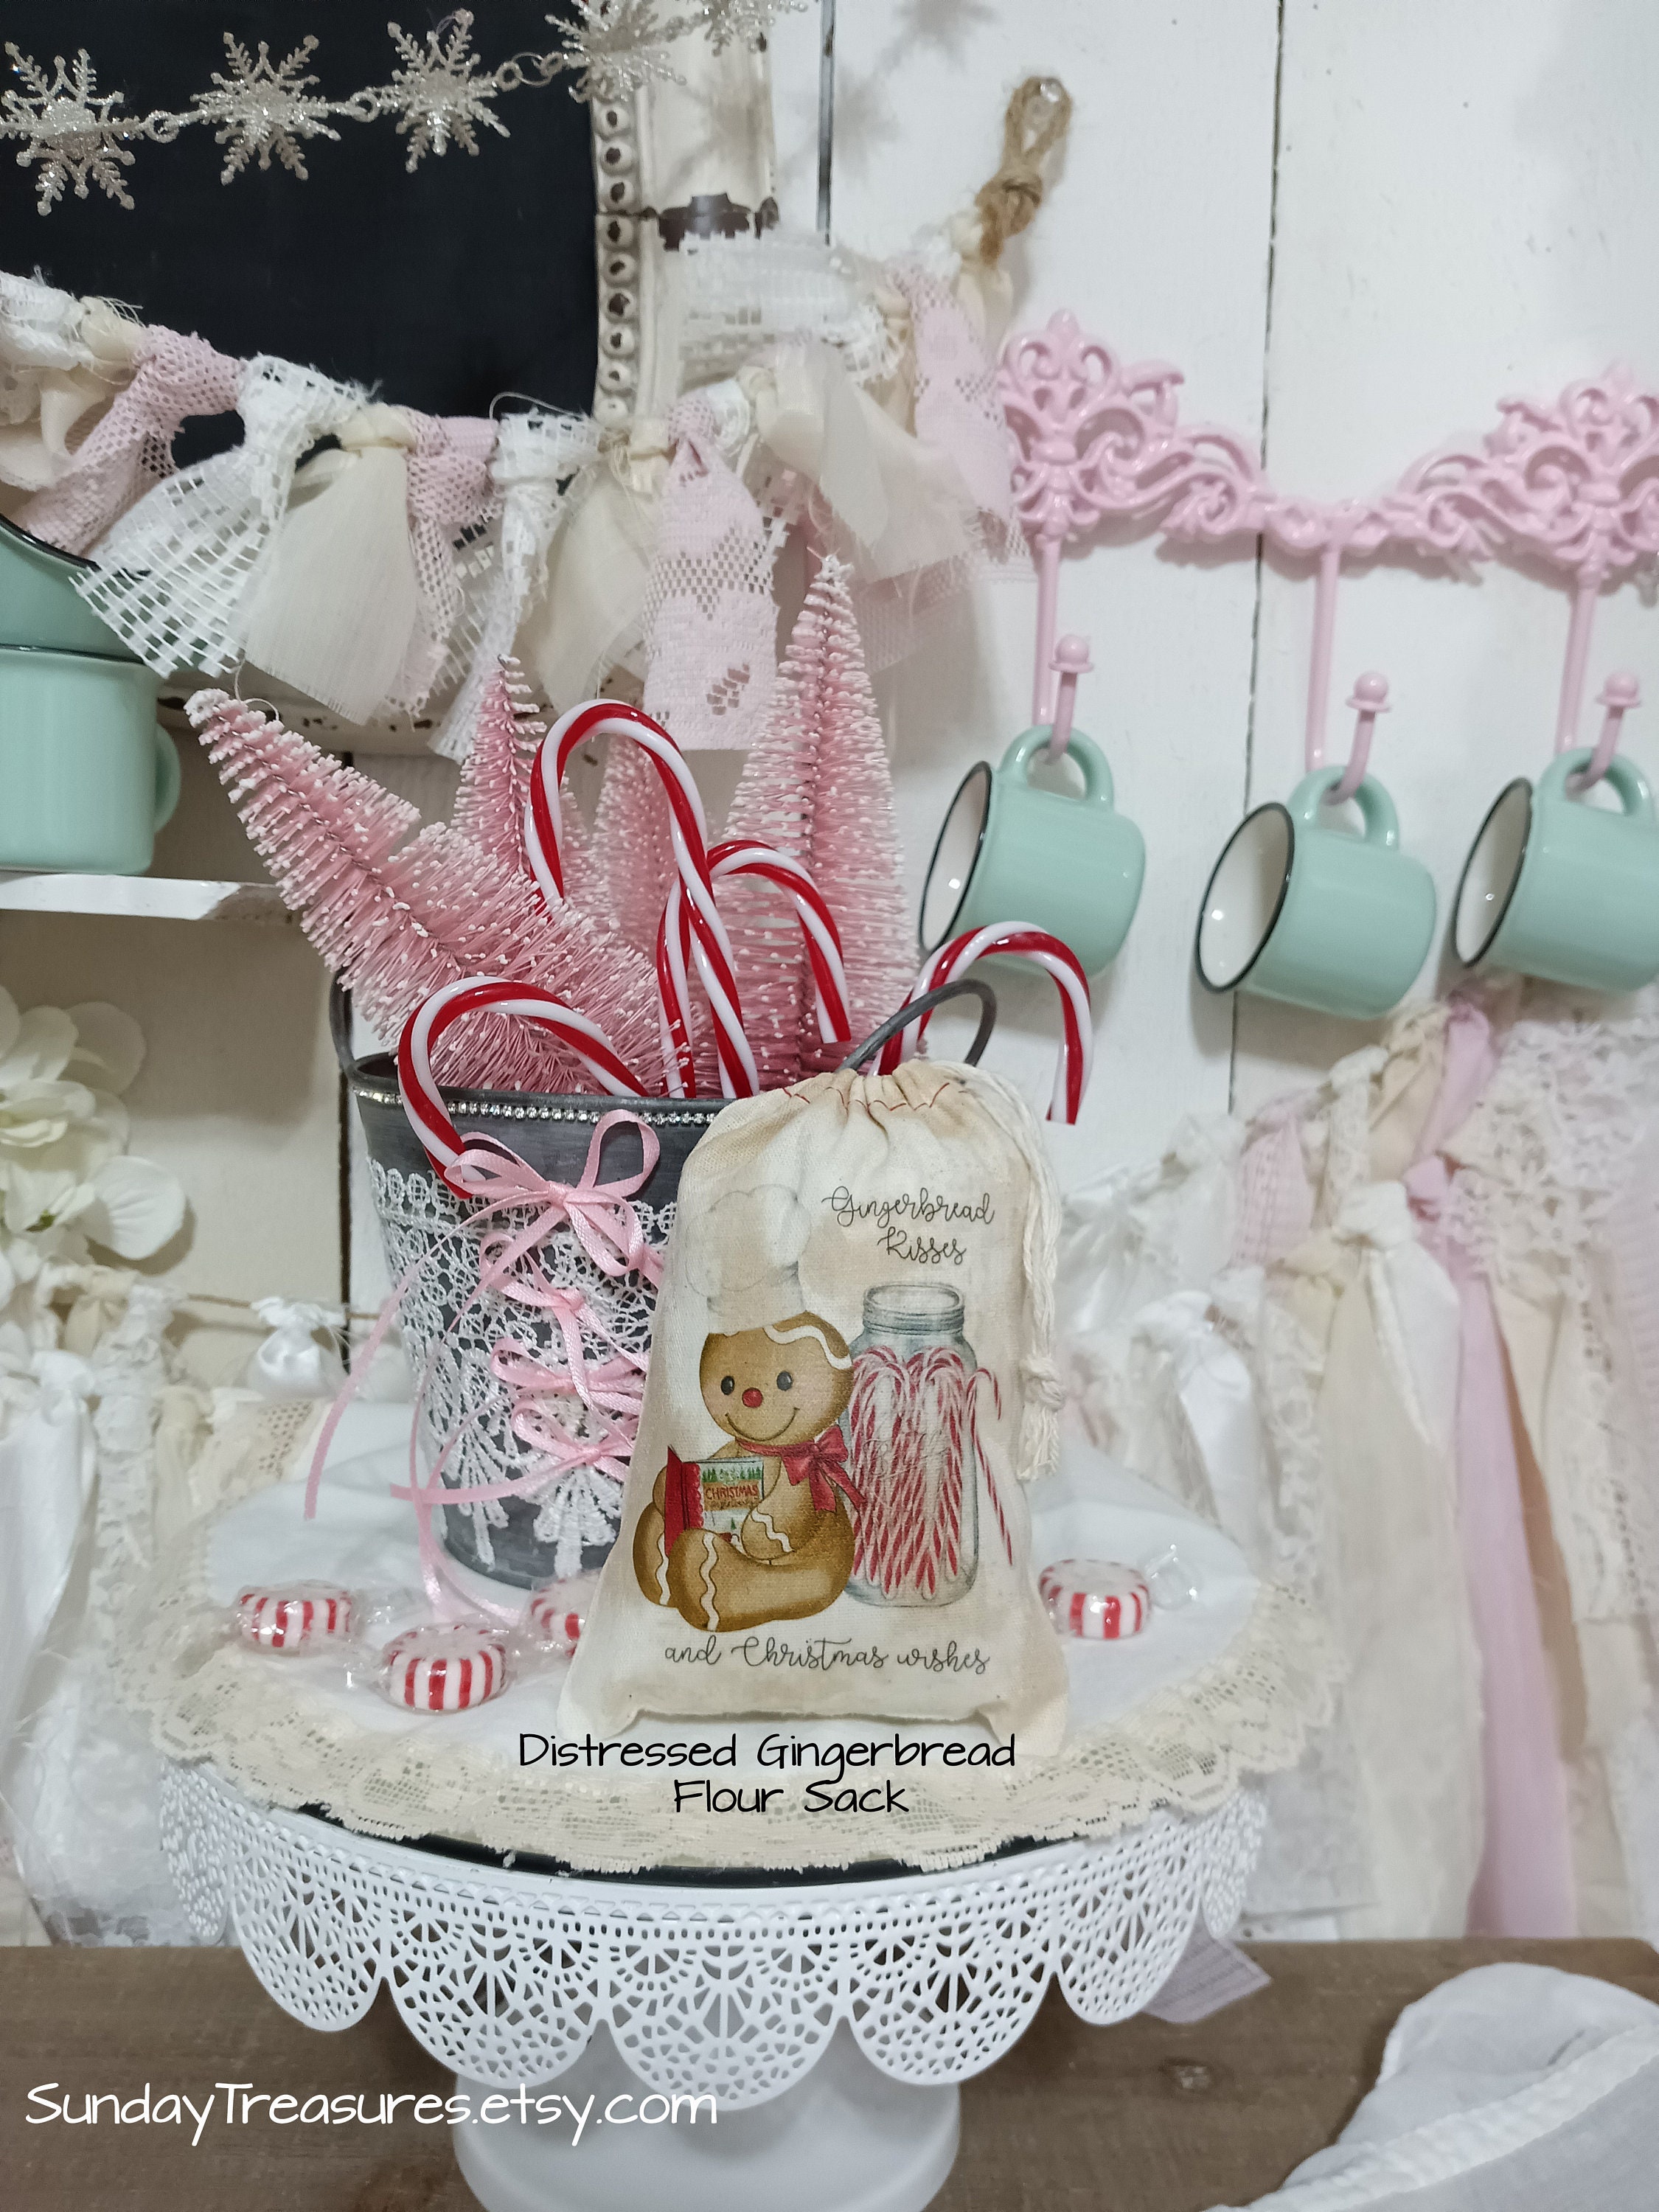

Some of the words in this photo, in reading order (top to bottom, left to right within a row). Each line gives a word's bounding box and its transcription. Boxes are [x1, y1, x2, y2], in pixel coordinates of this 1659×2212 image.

[821, 1186, 995, 1228] Gingerbread
[877, 1225, 967, 1265] Kisses
[705, 1484, 759, 1500] CHRISTMAS
[664, 1634, 722, 1666] and
[731, 1635, 888, 1671] Christmas
[897, 1640, 990, 1674] wishes
